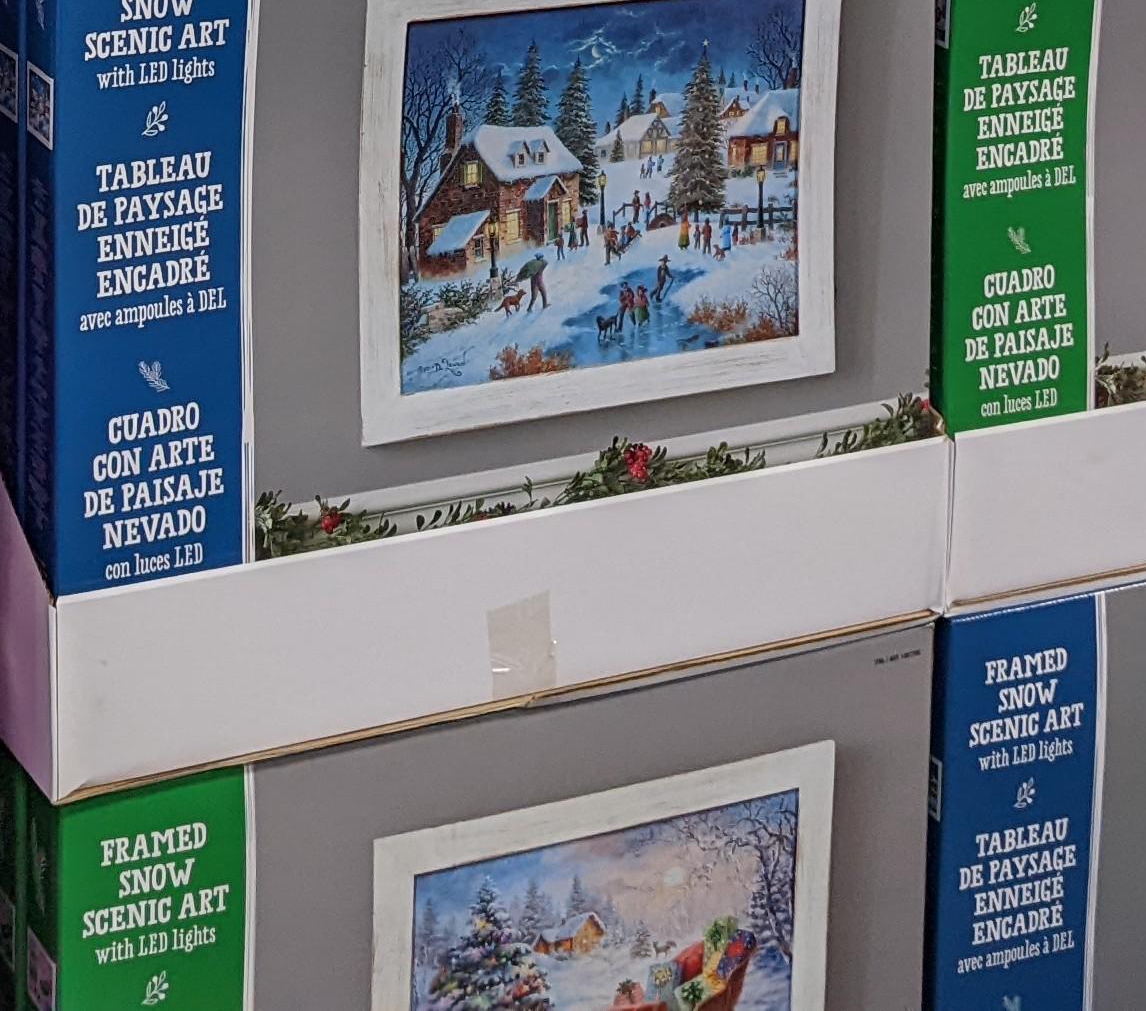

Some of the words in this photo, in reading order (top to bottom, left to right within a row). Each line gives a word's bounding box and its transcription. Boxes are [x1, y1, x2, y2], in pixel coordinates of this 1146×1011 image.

[85, 26, 172, 60] SCENIC
[178, 19, 230, 50] ART
[97, 63, 135, 89] with
[138, 60, 168, 84] LED
[171, 57, 215, 84] lights
[978, 48, 1068, 79] TABLEAU
[964, 86, 986, 112] DE
[990, 77, 1075, 108] PAYSAGE
[978, 103, 1063, 139] ENNEIGÉ
[97, 152, 211, 192] TABLEAU
[976, 134, 1063, 170] ENCADRÉ
[964, 182, 988, 199] avec
[990, 170, 1043, 198] ampoules
[1045, 173, 1052, 187] à
[1054, 166, 1075, 186] DEL
[78, 201, 107, 230] DE
[114, 184, 224, 225] PAYSAGE
[98, 221, 210, 262] ENNEIGÉ
[97, 250, 210, 297] ENCADRÉ
[79, 311, 112, 332] avec
[116, 295, 183, 328] ampoules
[186, 292, 196, 313] à
[199, 288, 227, 312] DEL
[109, 402, 200, 443] CUADRO
[94, 446, 141, 481] CON
[149, 434, 215, 471] ARTE
[83, 488, 114, 518] DE
[121, 468, 224, 511] PAISAJE
[103, 506, 205, 549] NEVADO
[105, 561, 131, 580] con
[134, 553, 171, 575] luces
[174, 543, 203, 568] LED
[985, 648, 1067, 684] FRAMED
[999, 678, 1058, 712] SNOW
[970, 712, 1040, 747] SCENIC
[1043, 703, 1083, 733] ART
[980, 747, 1010, 771] with
[1013, 743, 1036, 765] LED
[1038, 738, 1073, 762] lights
[101, 823, 207, 866] FRAMED
[118, 858, 195, 898] SNOW
[83, 897, 172, 939] SCENIC
[178, 885, 230, 920] ART
[96, 937, 134, 964] with
[138, 933, 168, 957] LED
[172, 926, 216, 952] lights
